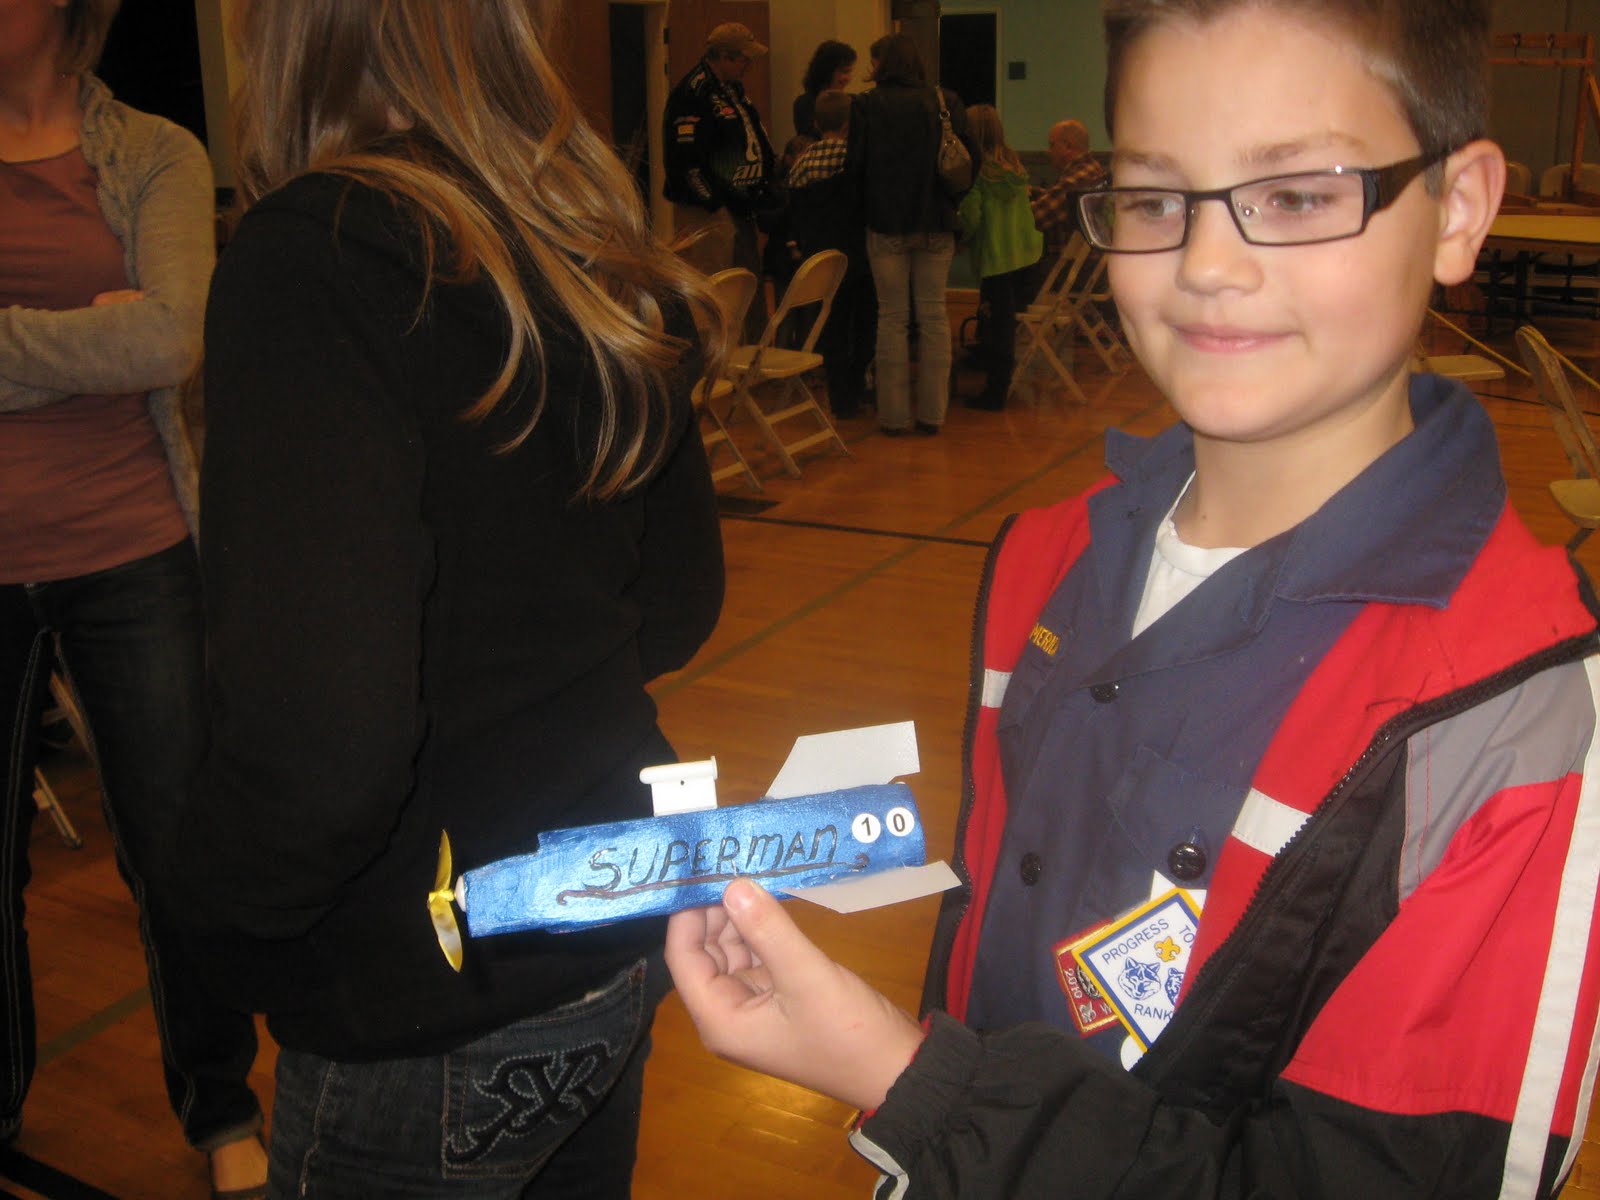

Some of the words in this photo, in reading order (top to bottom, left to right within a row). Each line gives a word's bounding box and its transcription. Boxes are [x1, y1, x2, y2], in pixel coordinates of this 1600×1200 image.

[582, 824, 838, 891] SUPERMAN
[1102, 918, 1170, 964] PROGRESS
[1178, 925, 1196, 949] TO
[1064, 968, 1083, 999] 2010
